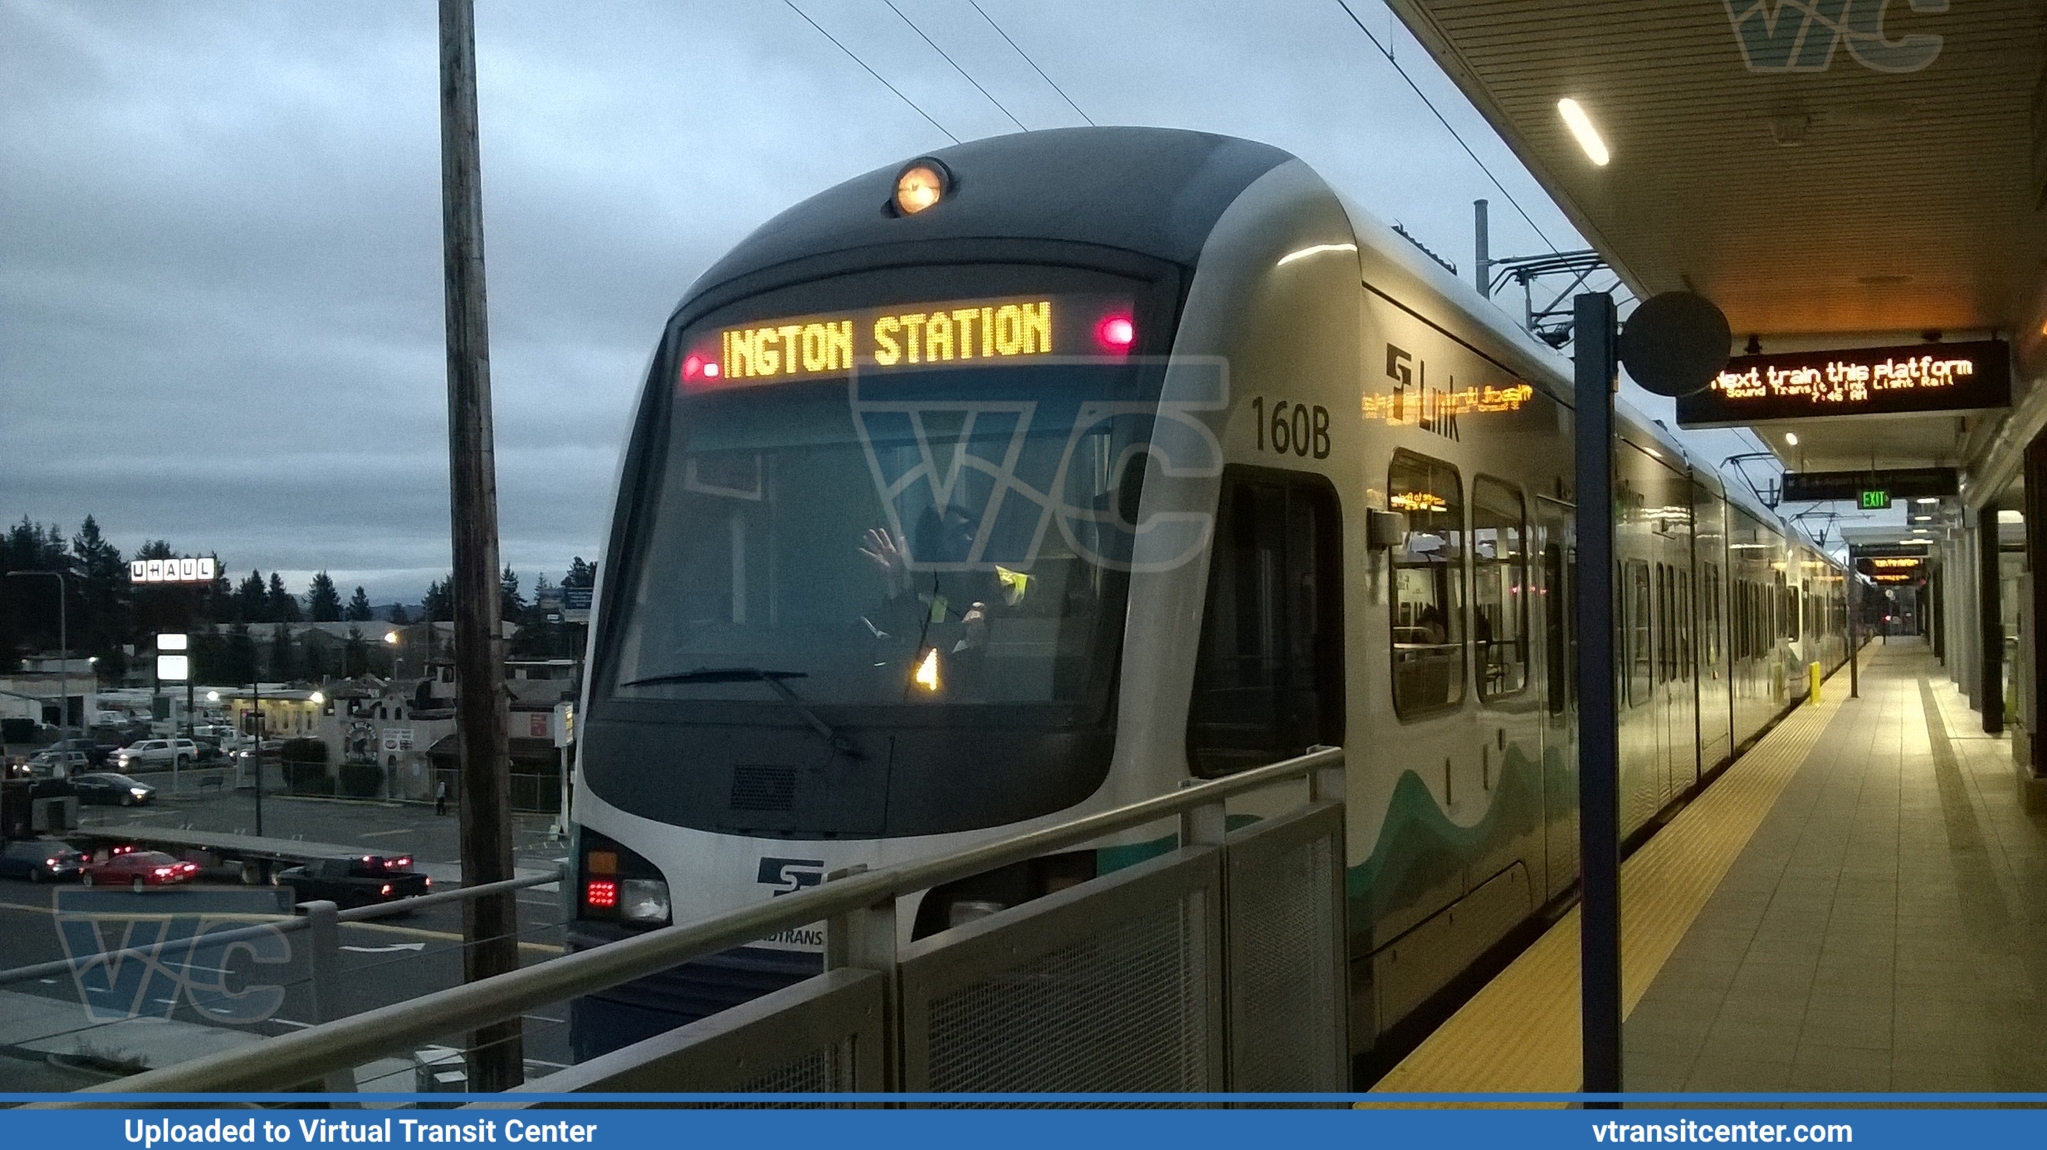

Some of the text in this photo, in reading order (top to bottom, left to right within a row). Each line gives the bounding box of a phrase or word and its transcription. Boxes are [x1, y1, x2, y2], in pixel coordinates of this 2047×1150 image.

[874, 302, 1052, 366] STATION
[1726, 385, 1766, 398] Sound
[1772, 381, 1828, 395] Transit
[1833, 379, 1866, 392] Link
[1920, 374, 1954, 387] Rail
[1766, 365, 1821, 386] train
[1826, 361, 1870, 382] this
[1874, 356, 1973, 379] platform
[1252, 396, 1331, 460] 160B
[1863, 491, 1885, 507] EXIT
